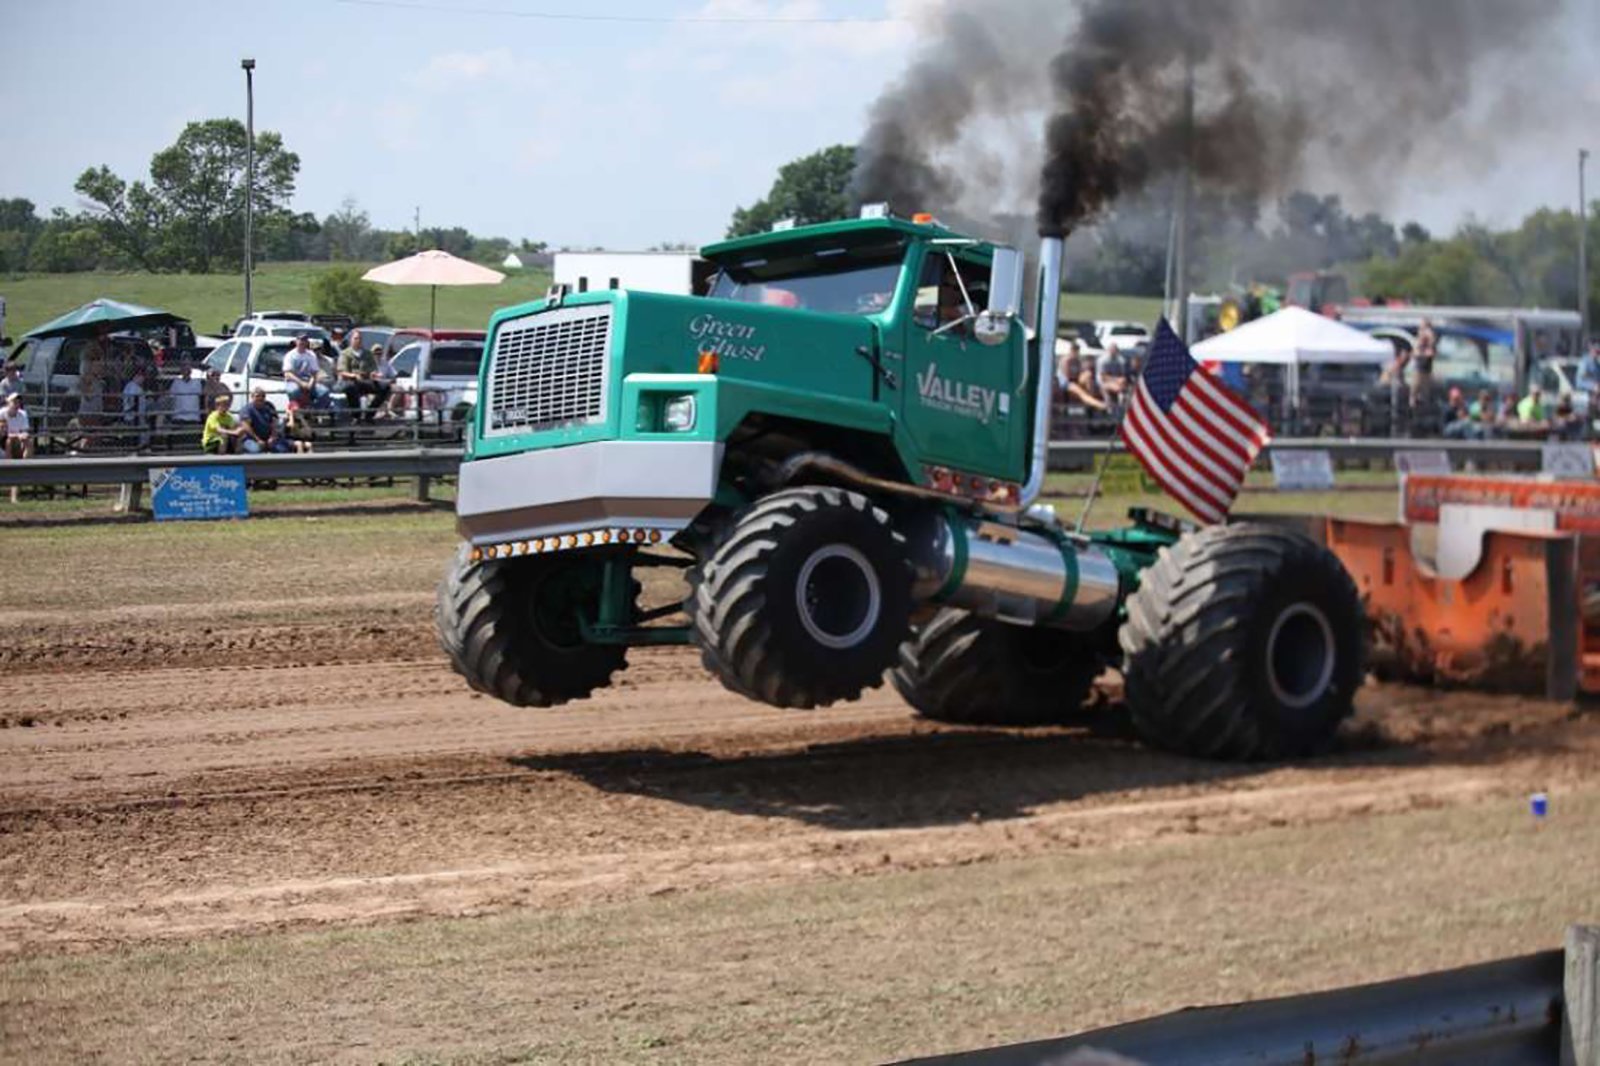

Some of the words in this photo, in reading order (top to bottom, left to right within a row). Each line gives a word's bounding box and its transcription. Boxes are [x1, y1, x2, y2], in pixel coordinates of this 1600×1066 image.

[689, 314, 756, 339] Green
[697, 337, 766, 361] Ghost
[916, 362, 996, 424] VALLEY
[209, 473, 239, 492] Shop
